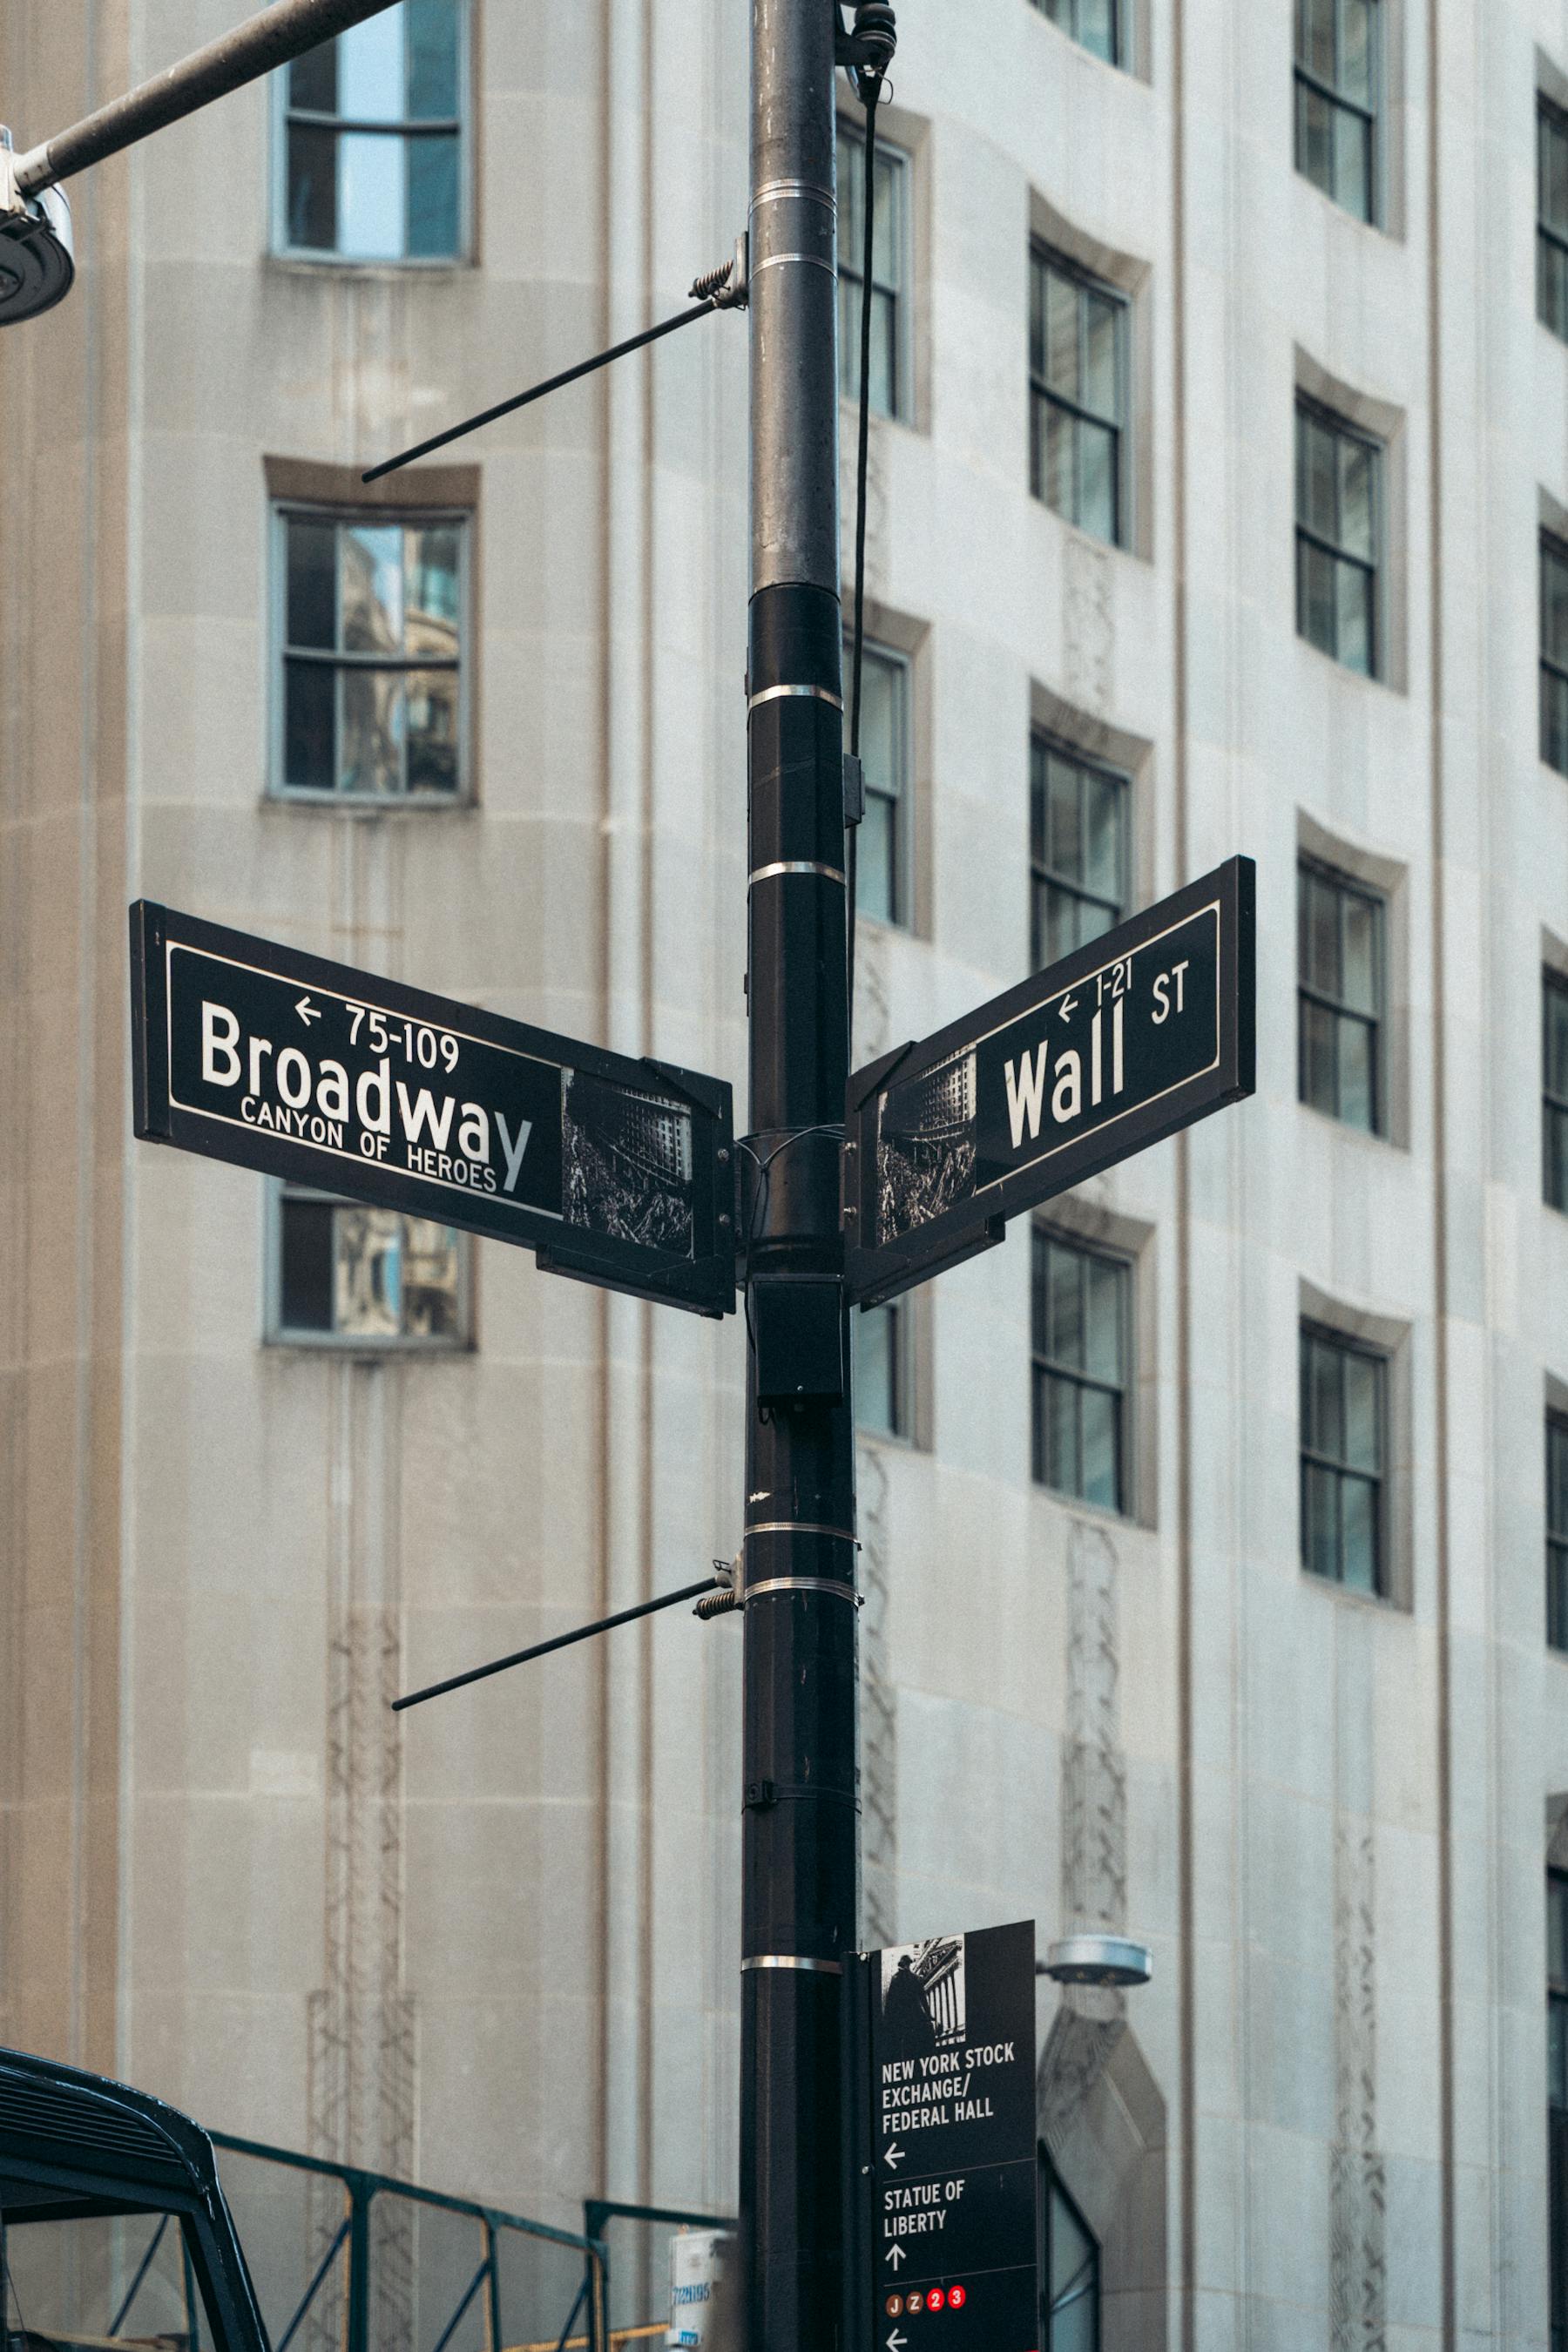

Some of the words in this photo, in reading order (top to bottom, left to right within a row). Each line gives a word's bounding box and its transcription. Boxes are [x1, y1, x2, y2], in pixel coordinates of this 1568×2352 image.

[1096, 956, 1132, 1007] 1-21
[345, 1004, 460, 1074] 75-109
[1004, 996, 1124, 1149] Wall
[1151, 960, 1189, 1024] ST
[201, 1000, 532, 1192] Broadway
[240, 1096, 343, 1149] CANYON
[360, 1131, 391, 1160] OF
[407, 1144, 497, 1193] HEROES
[882, 2059, 915, 2085] NEW
[919, 2051, 961, 2077] YORK
[965, 2041, 1015, 2069] STOCK
[882, 2072, 971, 2110] EXCHANGE/
[882, 2105, 950, 2134] FEDERAL
[955, 2097, 994, 2122] HALL
[884, 2183, 942, 2211] STATUE
[945, 2180, 965, 2201] OF
[884, 2209, 947, 2238] LIBERTY
[890, 2298, 899, 2314] J
[910, 2295, 920, 2310] Z
[931, 2292, 940, 2308] 2
[952, 2289, 961, 2305] 3
